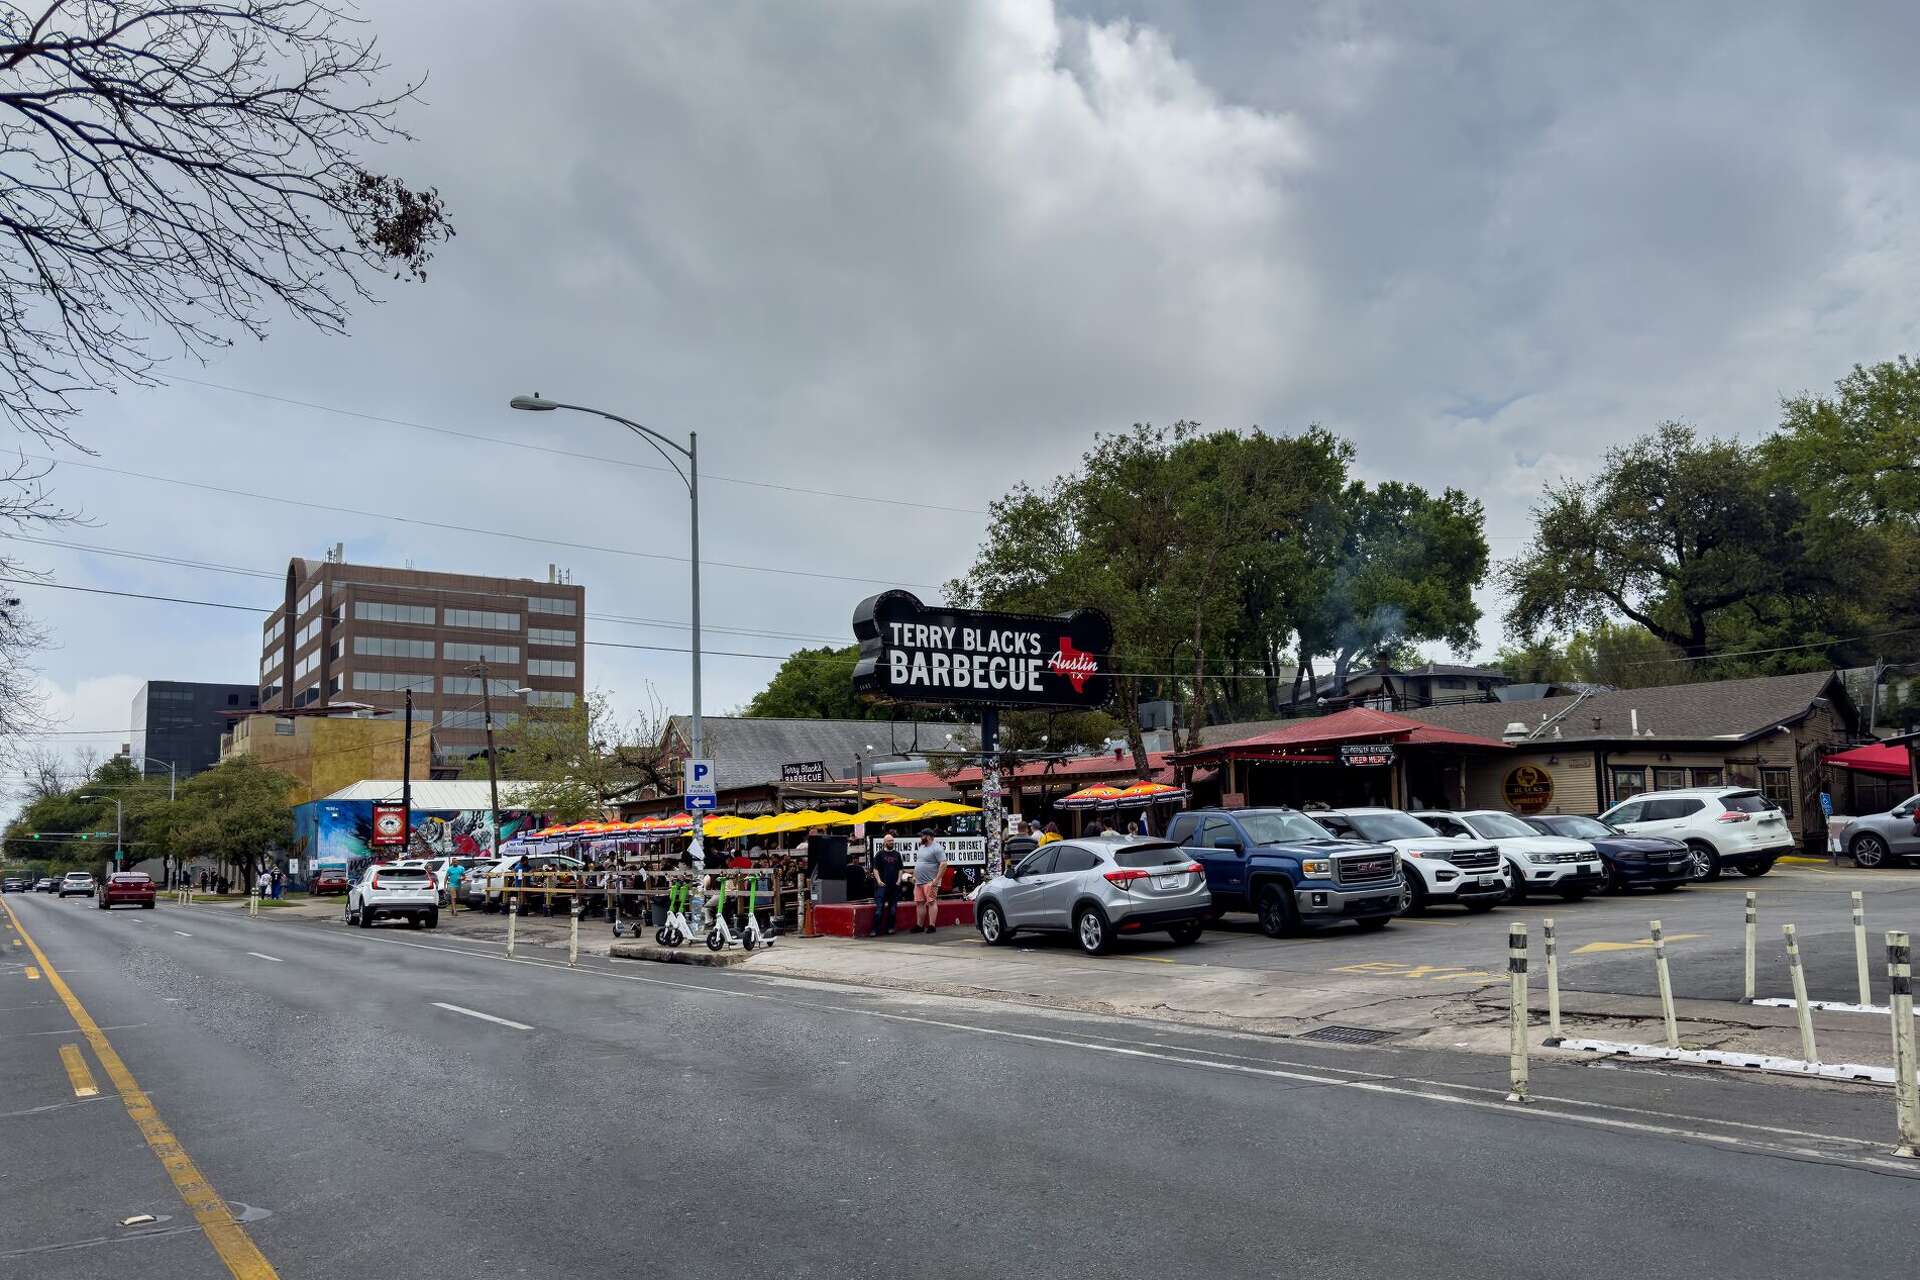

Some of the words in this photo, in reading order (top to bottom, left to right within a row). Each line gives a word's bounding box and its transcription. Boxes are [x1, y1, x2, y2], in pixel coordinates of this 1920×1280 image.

[889, 622, 956, 650] TERRY
[963, 627, 1042, 656] BLACK'S
[1047, 650, 1099, 672] Austin
[889, 649, 1044, 692] BARBECUE
[1070, 671, 1084, 680] TX
[694, 764, 708, 782] P
[894, 842, 912, 852] FILMS
[948, 841, 956, 851] TO
[958, 840, 983, 850] BRISKET
[958, 851, 985, 861] COVERED
